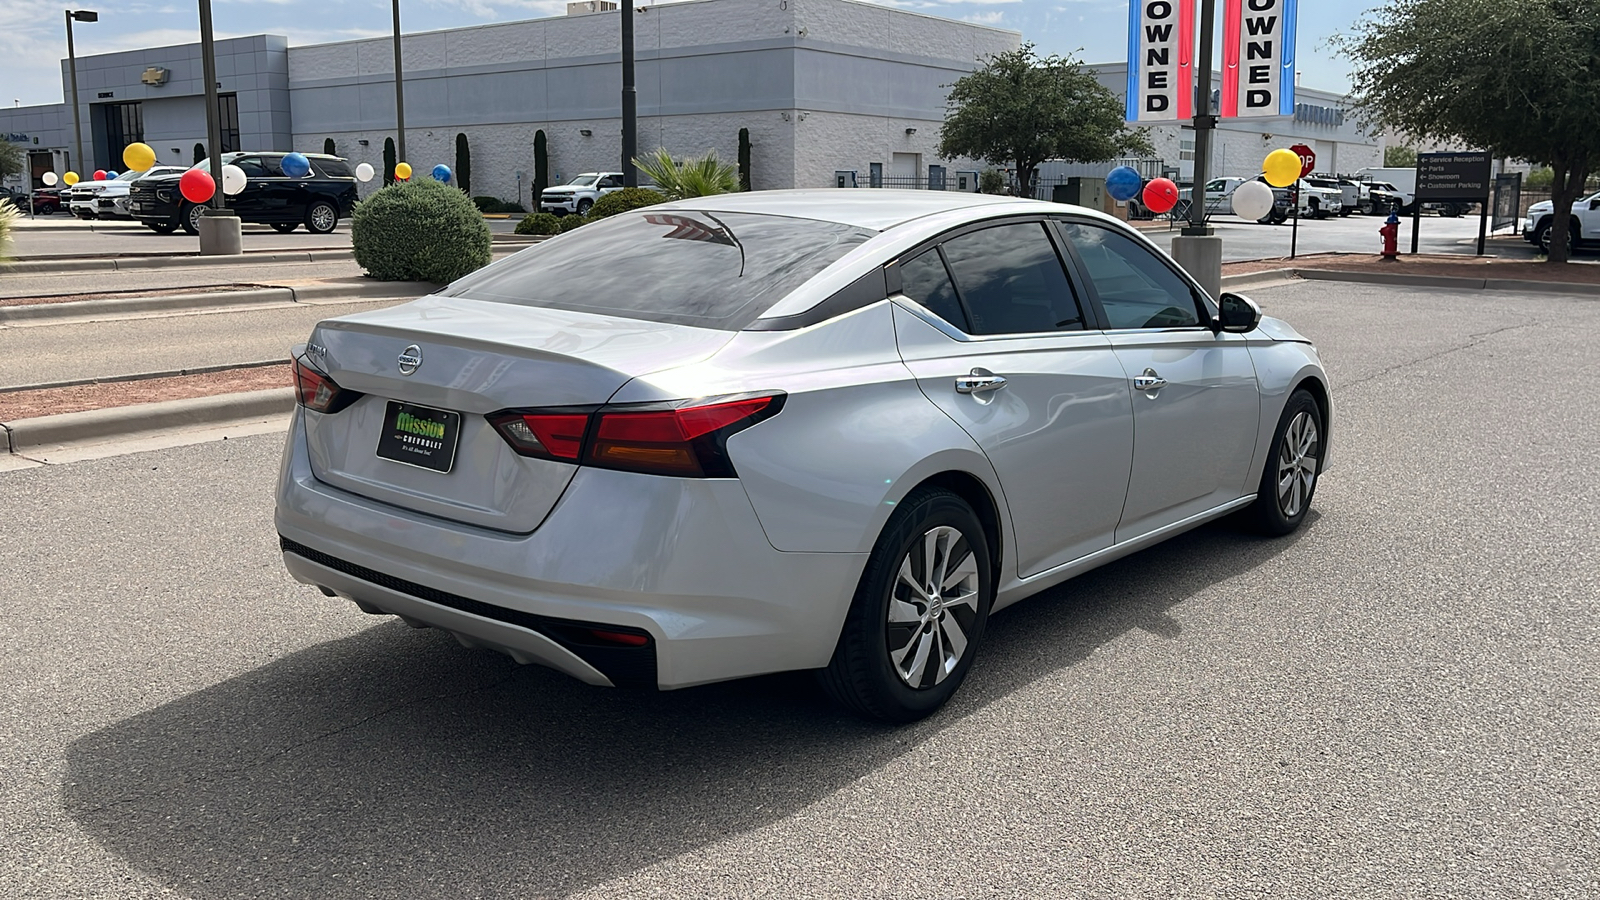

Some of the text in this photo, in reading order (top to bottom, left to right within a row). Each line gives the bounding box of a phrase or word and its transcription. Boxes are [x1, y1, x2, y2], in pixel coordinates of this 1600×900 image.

[1145, 1, 1172, 112] OWNED
[1245, 0, 1278, 108] OWNED
[1299, 155, 1314, 168] OP
[396, 412, 446, 440] Mission
[403, 435, 442, 450] CHEVROLET
